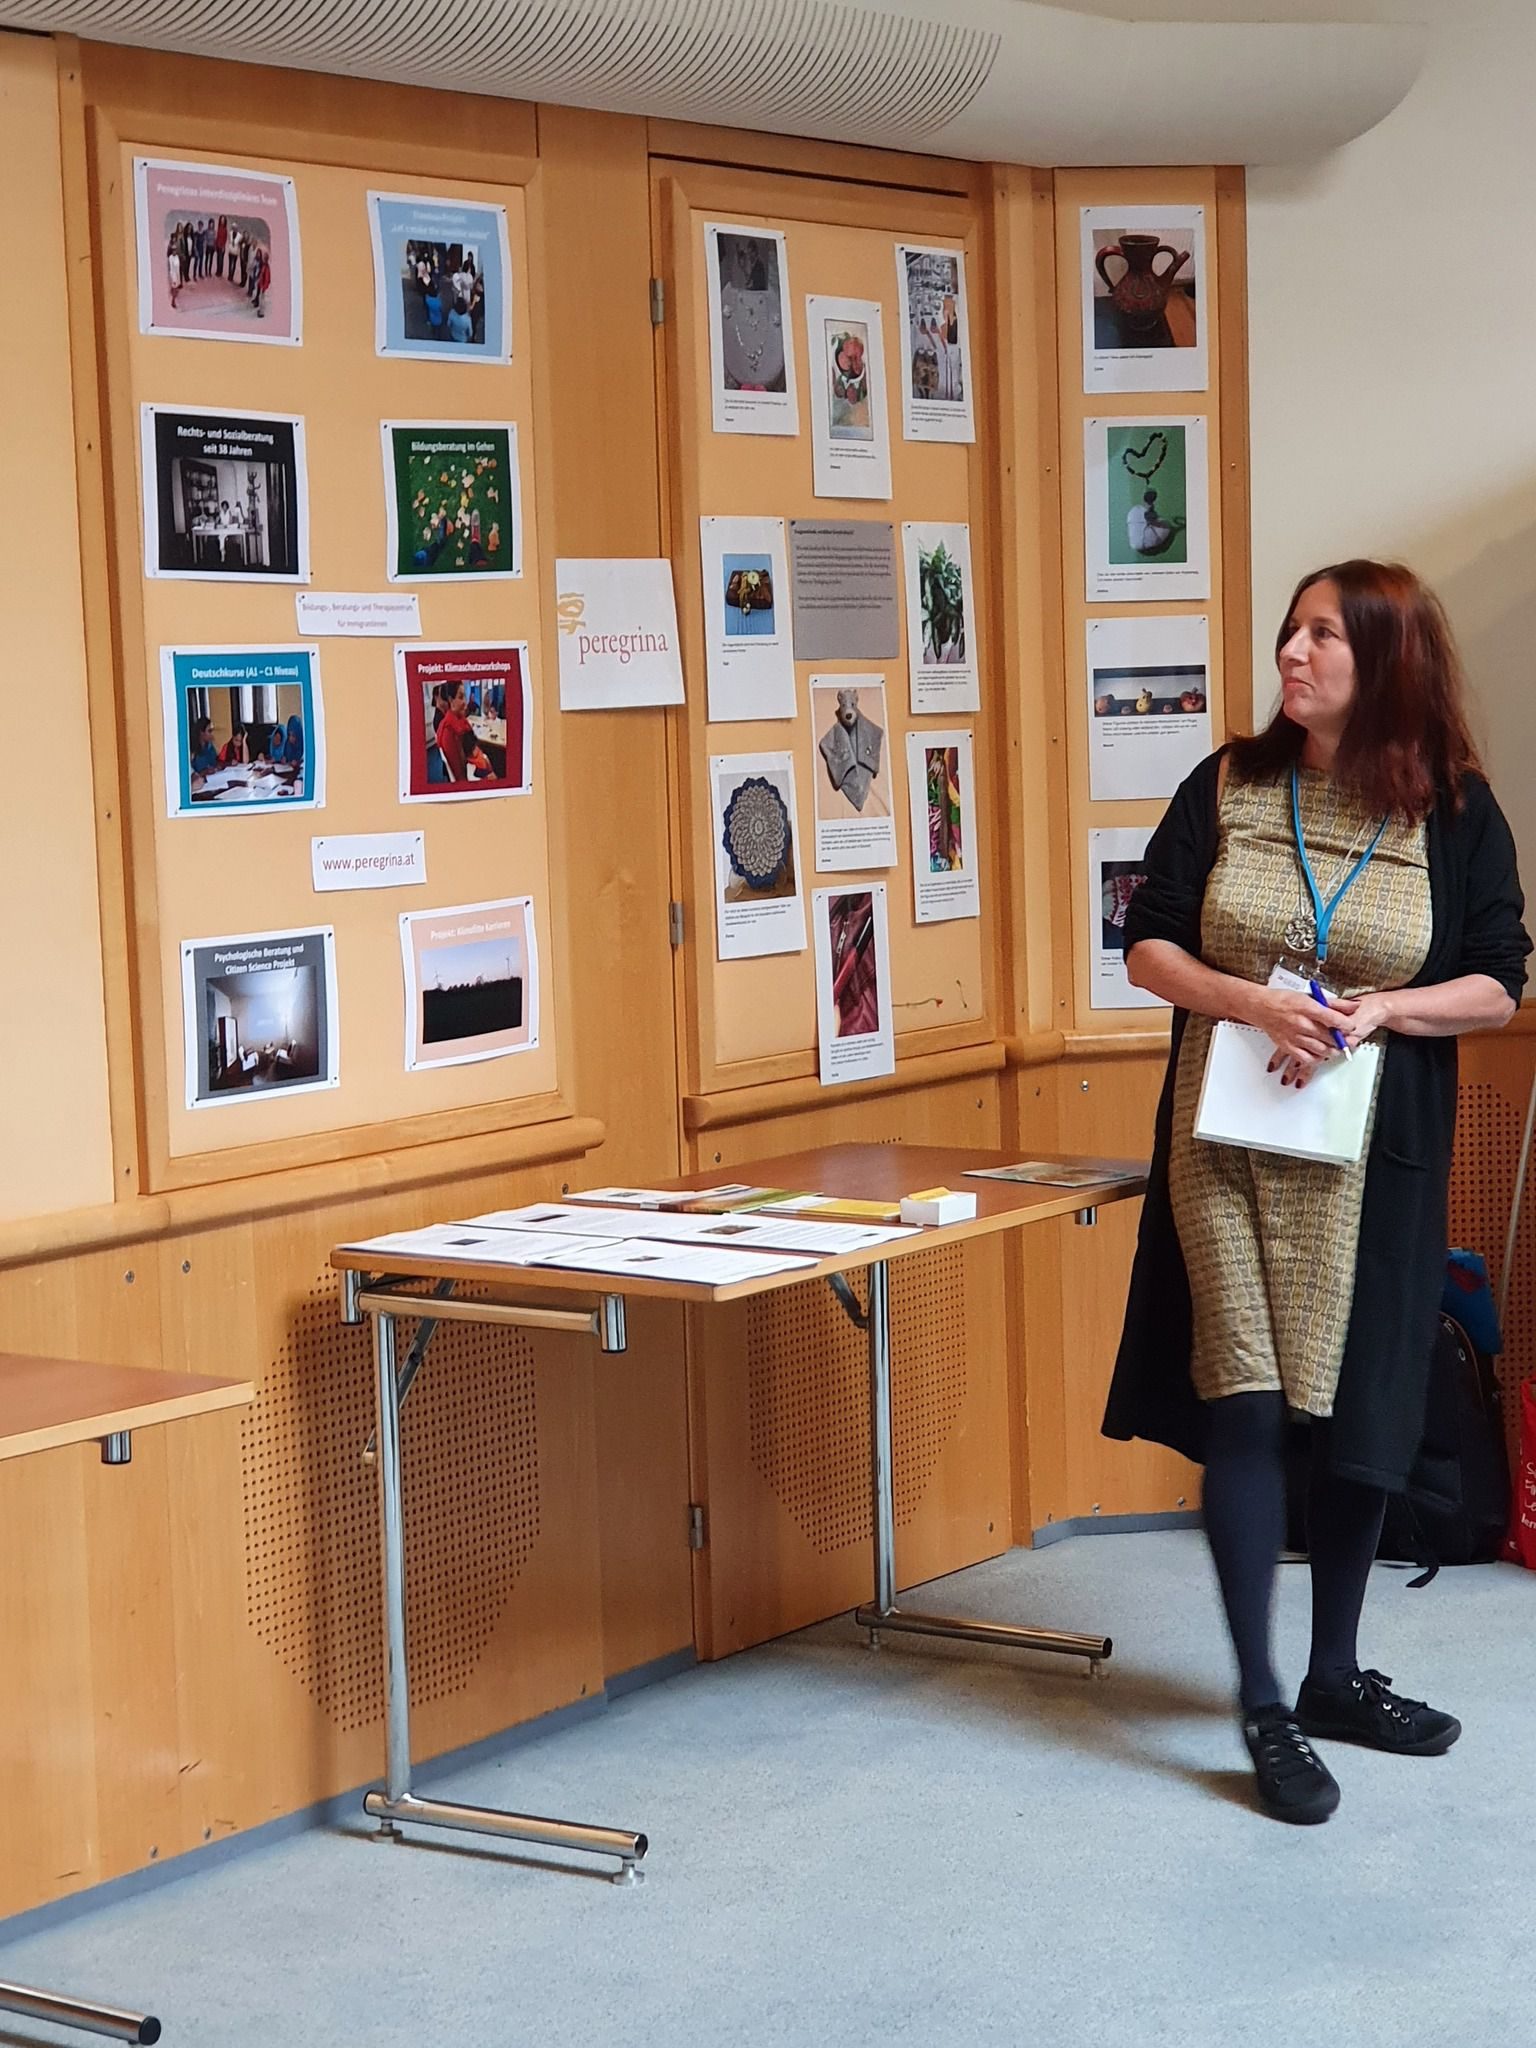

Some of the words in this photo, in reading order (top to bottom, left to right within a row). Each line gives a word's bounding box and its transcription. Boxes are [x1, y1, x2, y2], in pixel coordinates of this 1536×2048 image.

[177, 426, 206, 438] Rechts-
[207, 429, 222, 439] und
[223, 429, 274, 445] Sozialberatung
[203, 443, 217, 454] seit
[218, 444, 228, 455] 38
[229, 445, 253, 456] Jahren
[411, 441, 466, 454] Bildungsberatung
[467, 441, 475, 451] im
[476, 441, 495, 451] Gehen
[579, 625, 669, 665] peregrina
[192, 667, 245, 679] Deutschkurse
[245, 666, 258, 679] (A1
[264, 666, 273, 676] C1
[418, 663, 444, 675] Projekt:
[444, 661, 511, 672] Klimaschutzworkshops
[322, 852, 415, 871] www.peregrina.at
[214, 948, 262, 963] Psychologische
[263, 946, 291, 957] Beratung
[292, 943, 304, 954] und
[225, 965, 248, 975] Citizen
[248, 962, 272, 972] Science
[273, 957, 295, 970] Projekt
